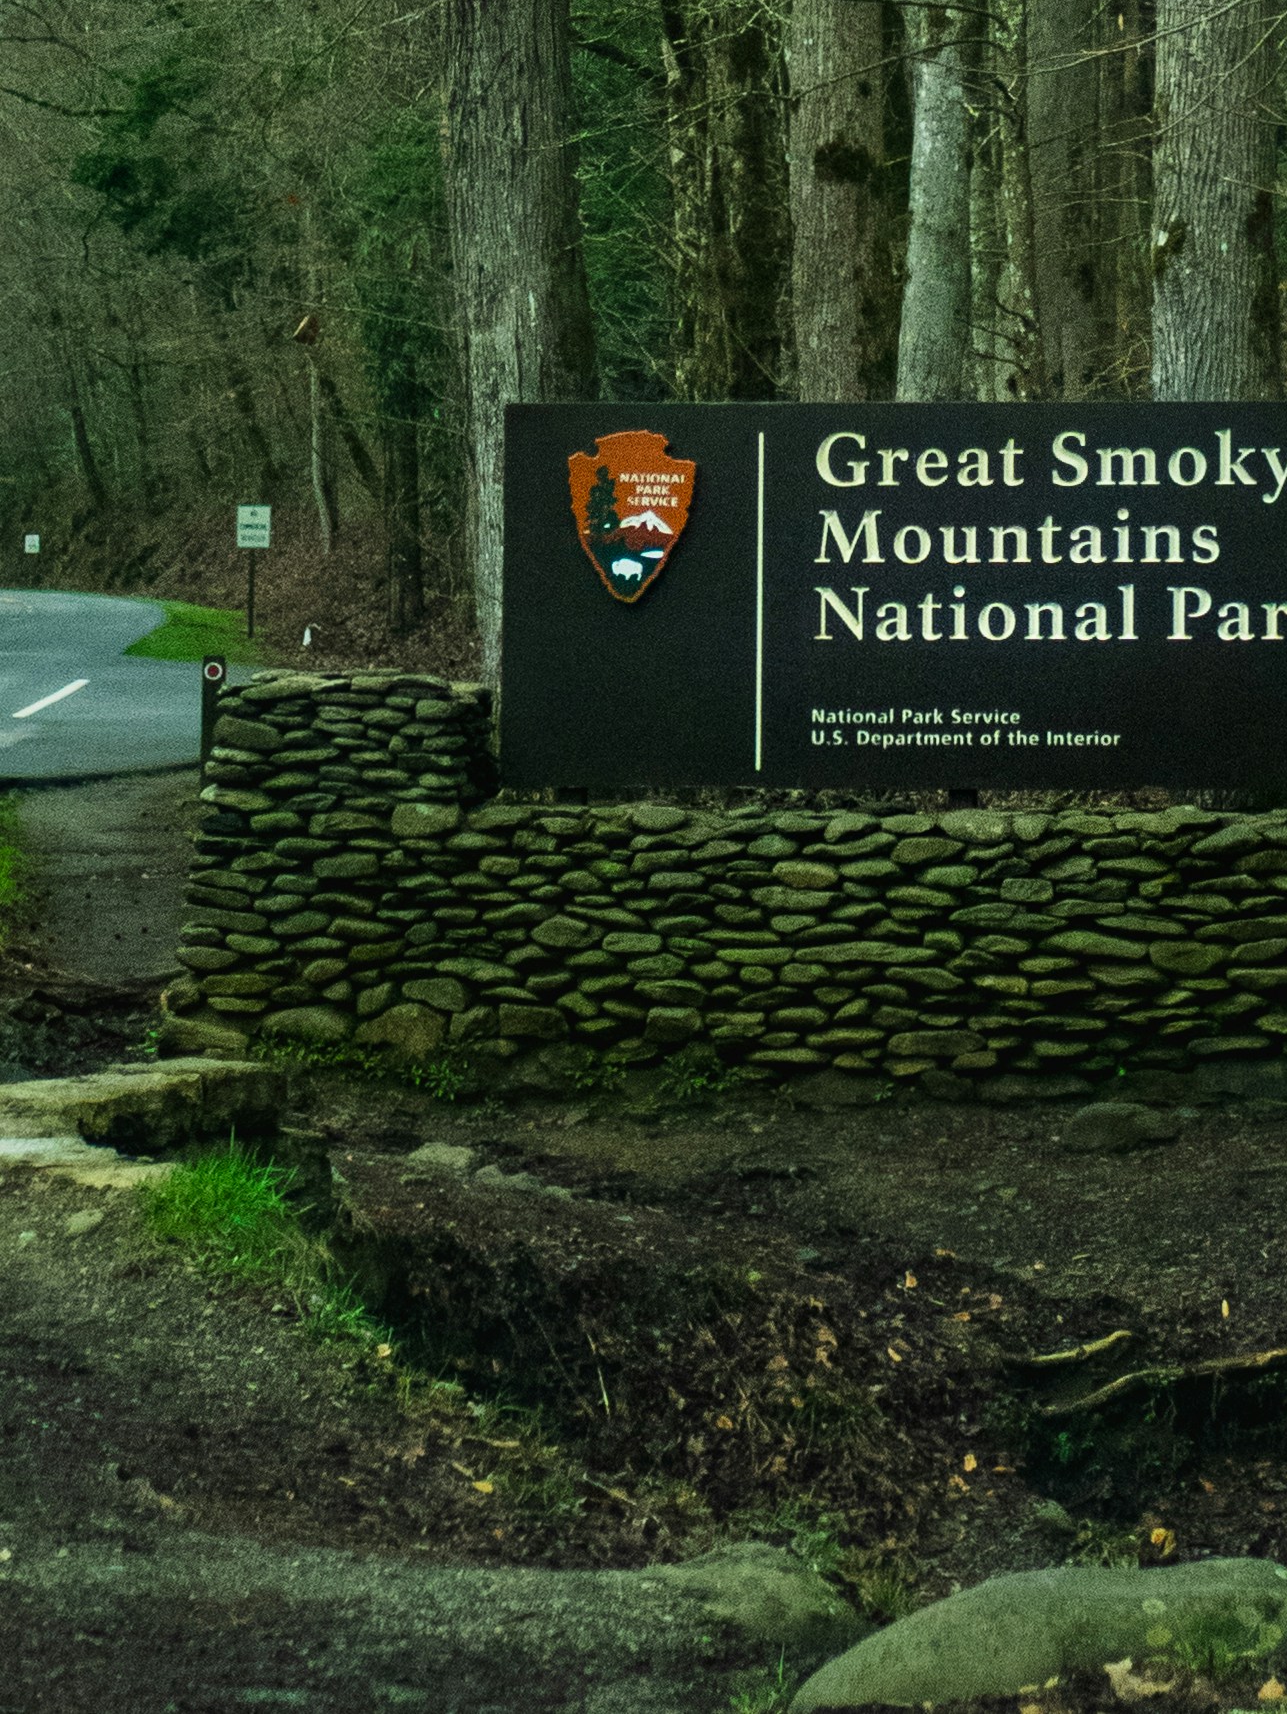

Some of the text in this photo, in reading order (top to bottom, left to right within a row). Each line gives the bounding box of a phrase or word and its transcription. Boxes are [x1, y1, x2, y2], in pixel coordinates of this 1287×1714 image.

[815, 431, 1025, 488] Great
[619, 473, 685, 483] NATIONAL
[636, 485, 670, 495] PARK
[627, 497, 679, 507] SERVICE
[813, 508, 1221, 565] Mountains
[813, 583, 1139, 642] National
[811, 707, 1021, 725] National Park Service
[810, 729, 1121, 750] U.S. Department of the Interior
